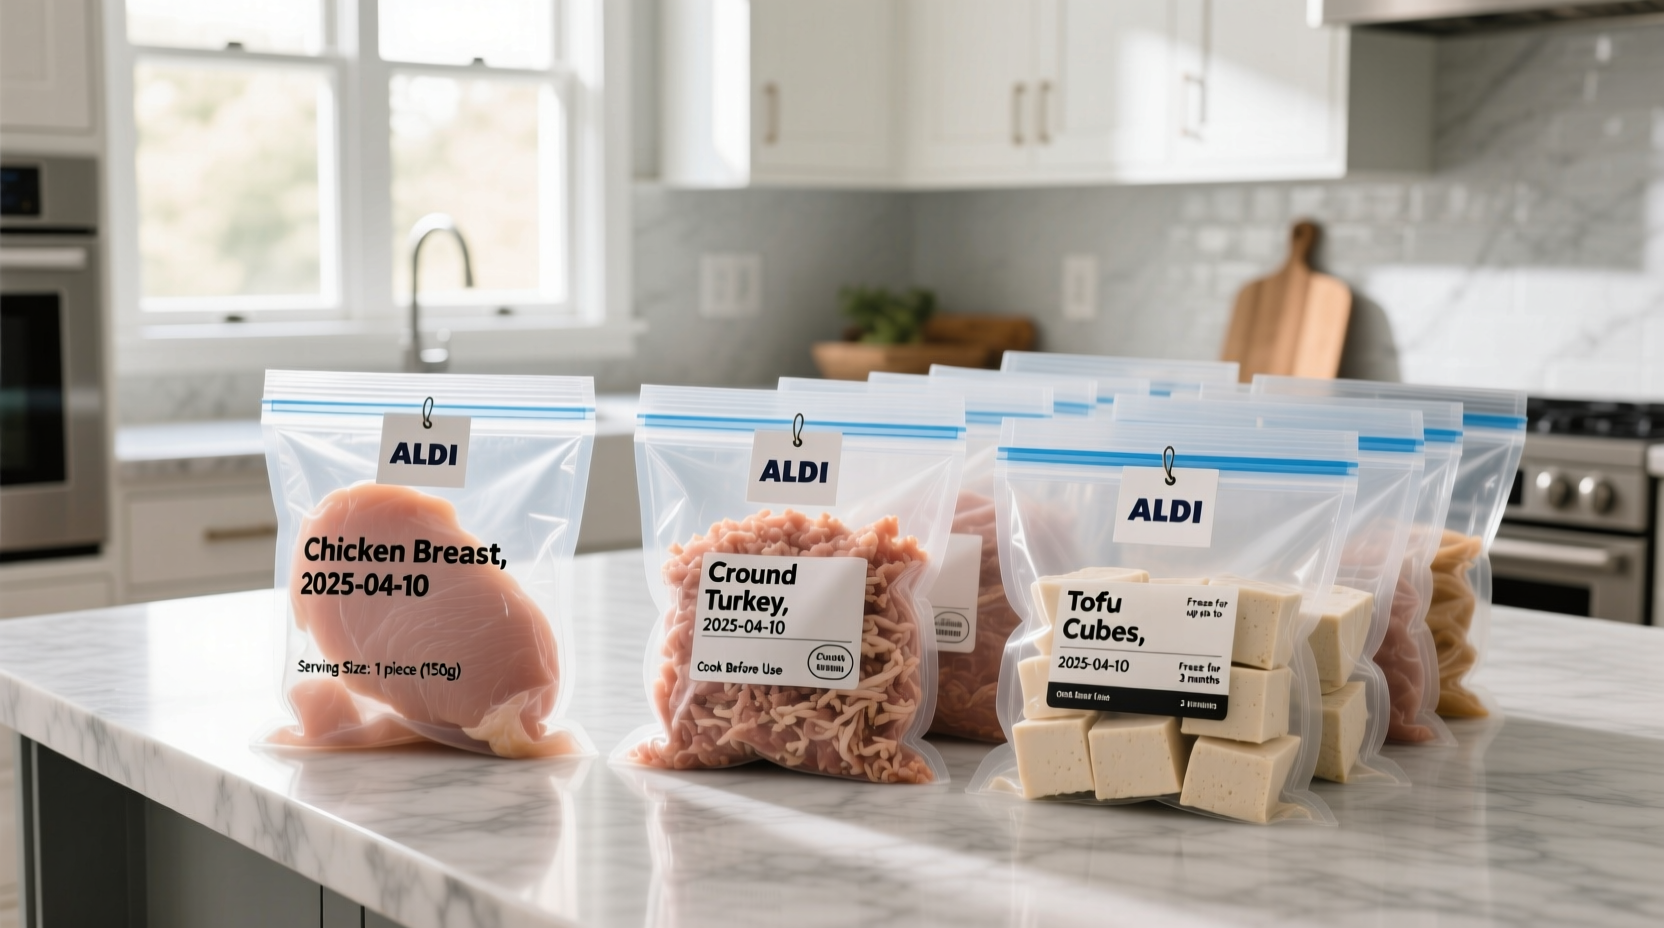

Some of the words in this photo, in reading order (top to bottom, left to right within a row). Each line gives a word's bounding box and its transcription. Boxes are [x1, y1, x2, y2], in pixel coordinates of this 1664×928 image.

[389, 441, 459, 466] ALDI
[758, 459, 829, 484] ALDI
[1127, 497, 1203, 524] ALDI
[303, 536, 406, 563] Chicken
[413, 539, 508, 570] Breast,
[300, 572, 430, 597] 2025-04-10
[704, 588, 790, 617] Turkey,
[1067, 590, 1123, 614] Tofu
[702, 617, 786, 636] 2025-04-10
[1062, 617, 1146, 647] Cubes,
[297, 659, 339, 677] Serving
[374, 662, 381, 676] 1
[384, 662, 417, 679] piece
[420, 662, 462, 681] (150g)
[697, 660, 722, 673] Cook
[762, 662, 783, 675] Use
[1057, 655, 1130, 673] 2025-04-10
